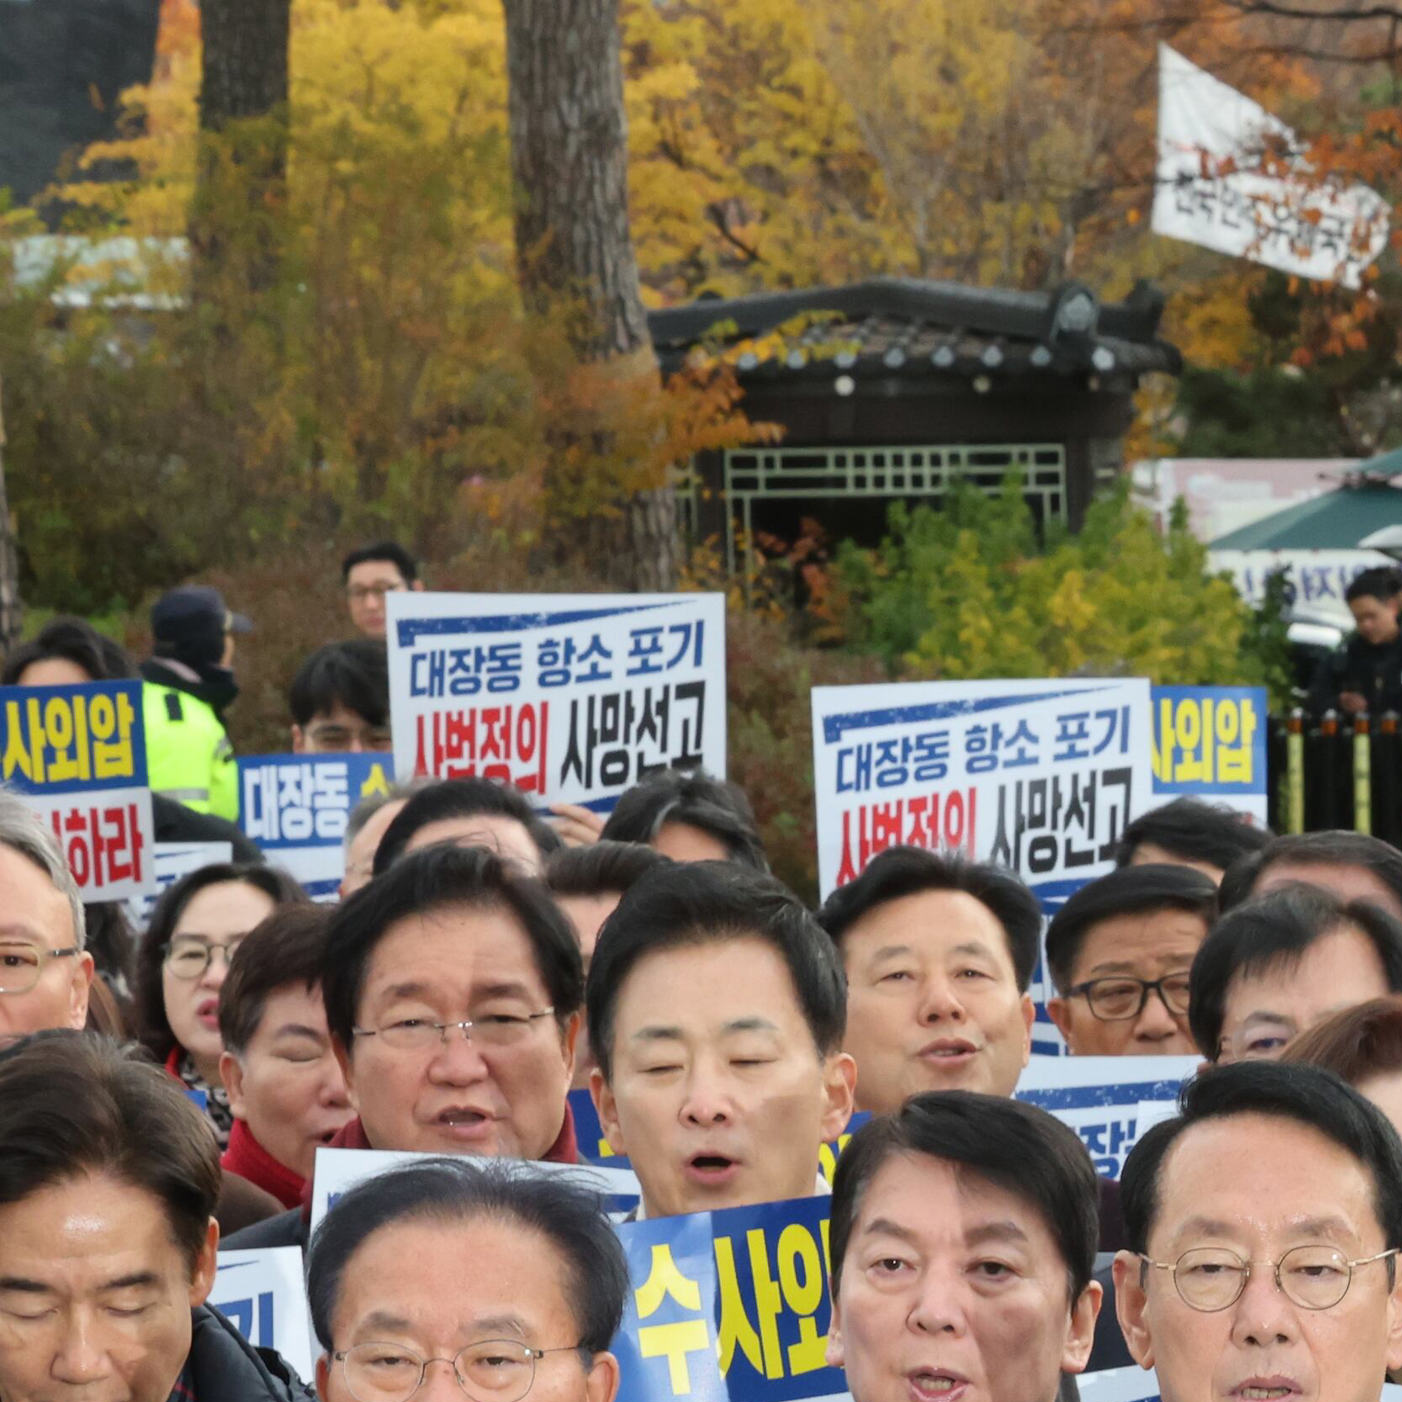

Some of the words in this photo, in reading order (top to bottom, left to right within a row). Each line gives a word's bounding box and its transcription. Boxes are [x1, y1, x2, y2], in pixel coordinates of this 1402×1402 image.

[410, 643, 523, 697] 대장동
[537, 636, 613, 688] 항소
[626, 620, 705, 675] 포기
[560, 680, 706, 790] 사망선고
[836, 730, 950, 794] 대장동
[965, 719, 1040, 773] 항소
[1054, 705, 1130, 760] 포기
[243, 762, 350, 841] 대장동
[52, 803, 143, 888] 하라
[634, 1219, 831, 1397] 수사외
